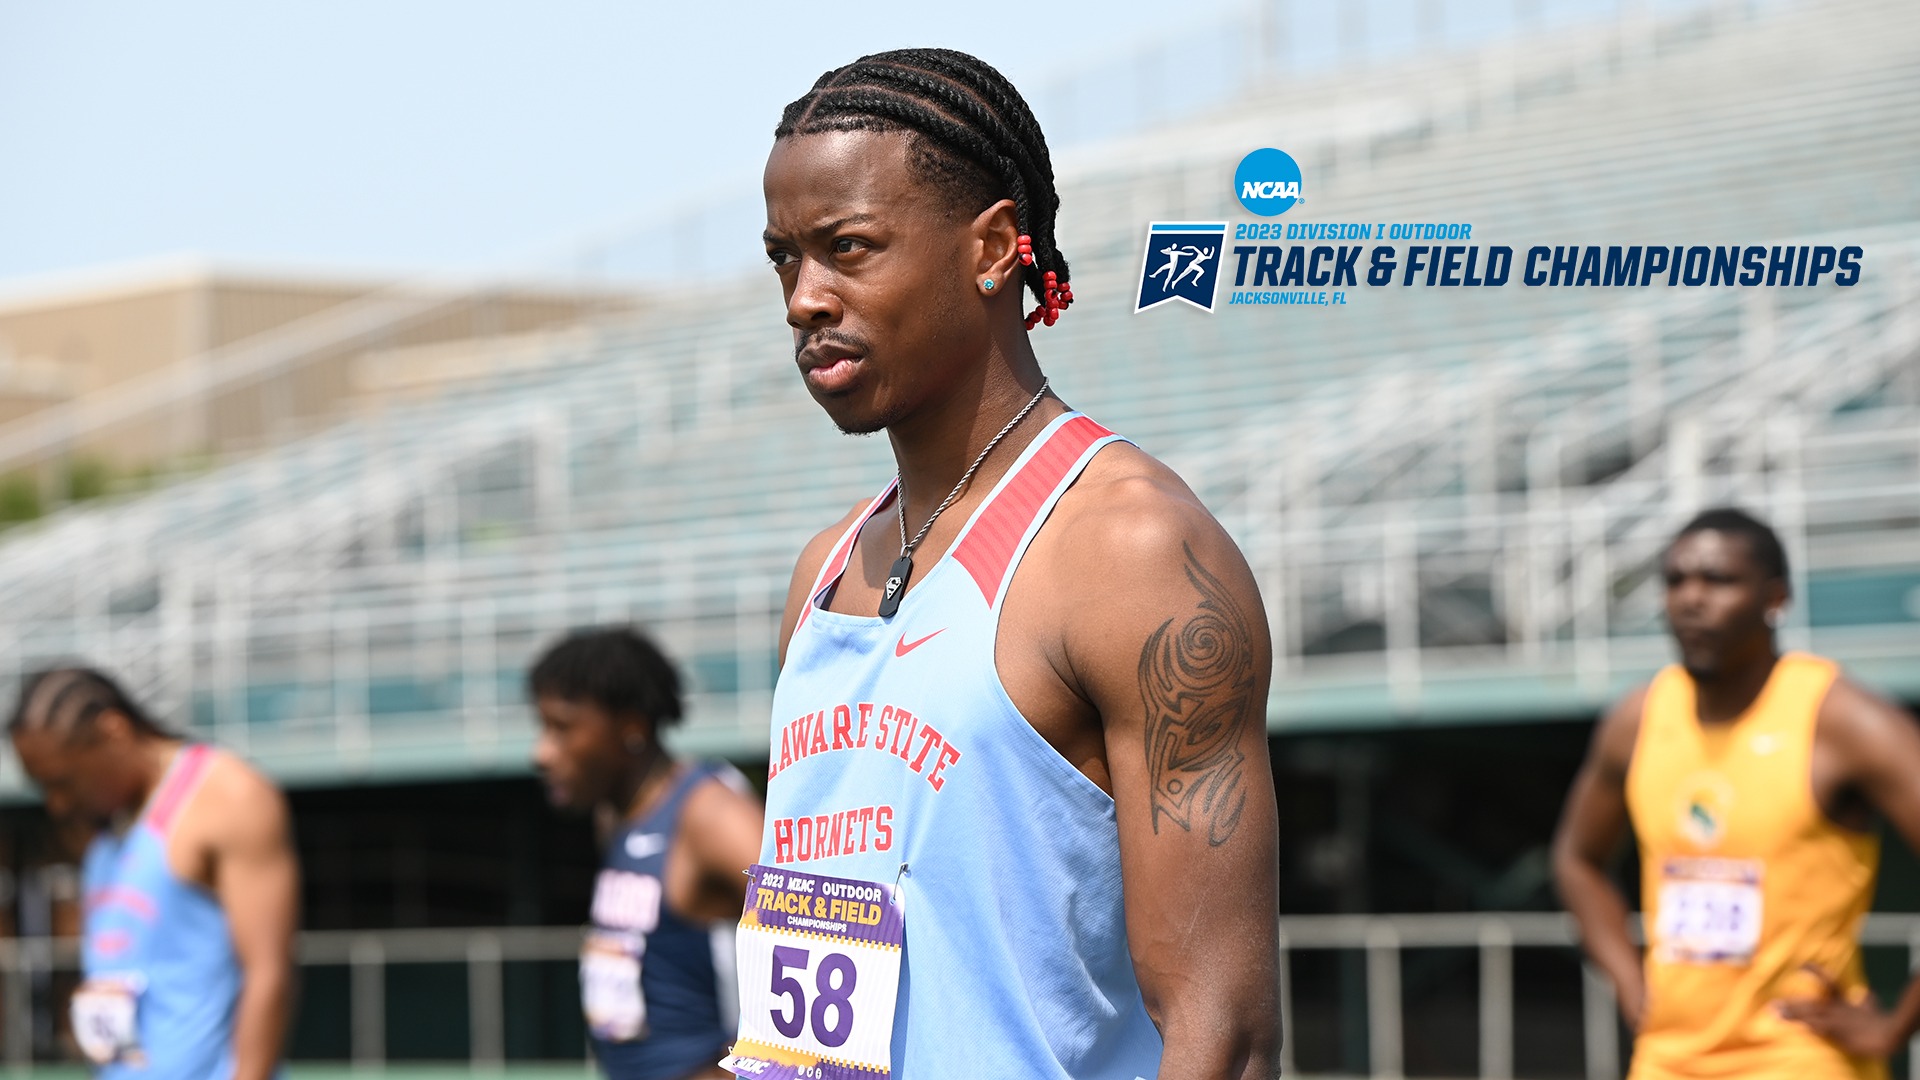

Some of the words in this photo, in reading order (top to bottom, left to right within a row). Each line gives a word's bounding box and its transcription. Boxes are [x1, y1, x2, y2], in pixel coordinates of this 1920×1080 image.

[773, 805, 894, 864] HORNETS
[755, 887, 813, 917] TRACK
[813, 896, 828, 919] &
[829, 898, 882, 926] FIELD
[761, 872, 785, 889] 2023
[787, 876, 815, 894] MEAC
[822, 881, 882, 903] OUTDOOR
[787, 915, 848, 933] CHAMPIONSHIPS
[769, 944, 857, 1048] 58
